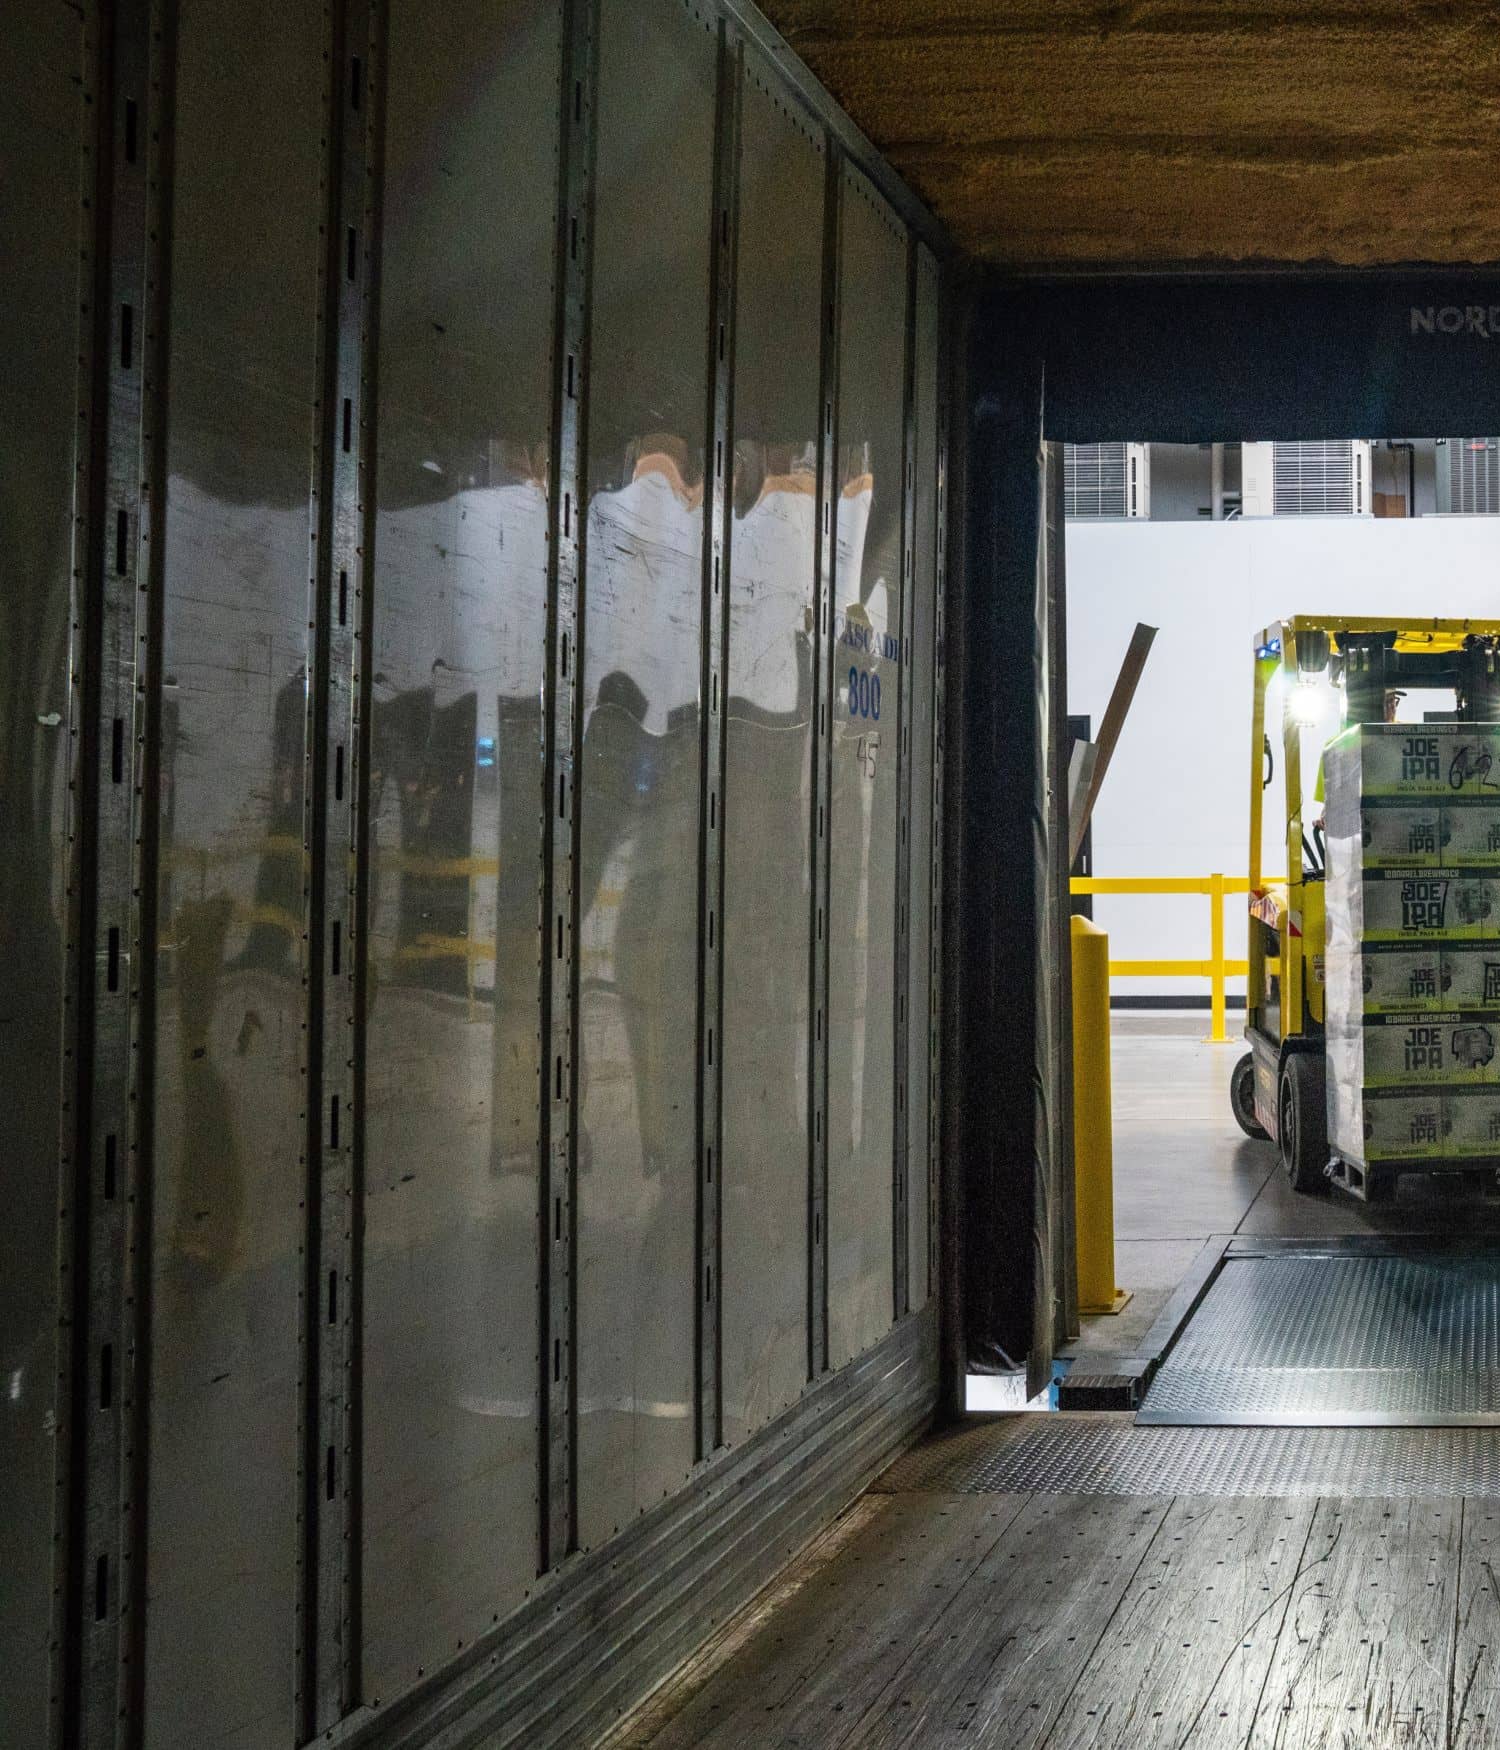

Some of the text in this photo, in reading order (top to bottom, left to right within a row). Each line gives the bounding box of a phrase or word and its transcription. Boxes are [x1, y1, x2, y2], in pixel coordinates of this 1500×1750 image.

[848, 665, 882, 721] 800
[1402, 738, 1439, 756] JOE
[1402, 757, 1440, 780] IPA
[1409, 824, 1434, 836] JOE
[1409, 837, 1435, 853] IPA
[1402, 883, 1441, 901] JOE
[1402, 903, 1441, 925] IPA
[1409, 969, 1435, 981] JOE
[1409, 982, 1435, 997] IPA
[1404, 1028, 1442, 1046] JOE
[1404, 1047, 1443, 1070] IPA
[1410, 1114, 1436, 1126] JOE
[1410, 1127, 1436, 1143] IPA
